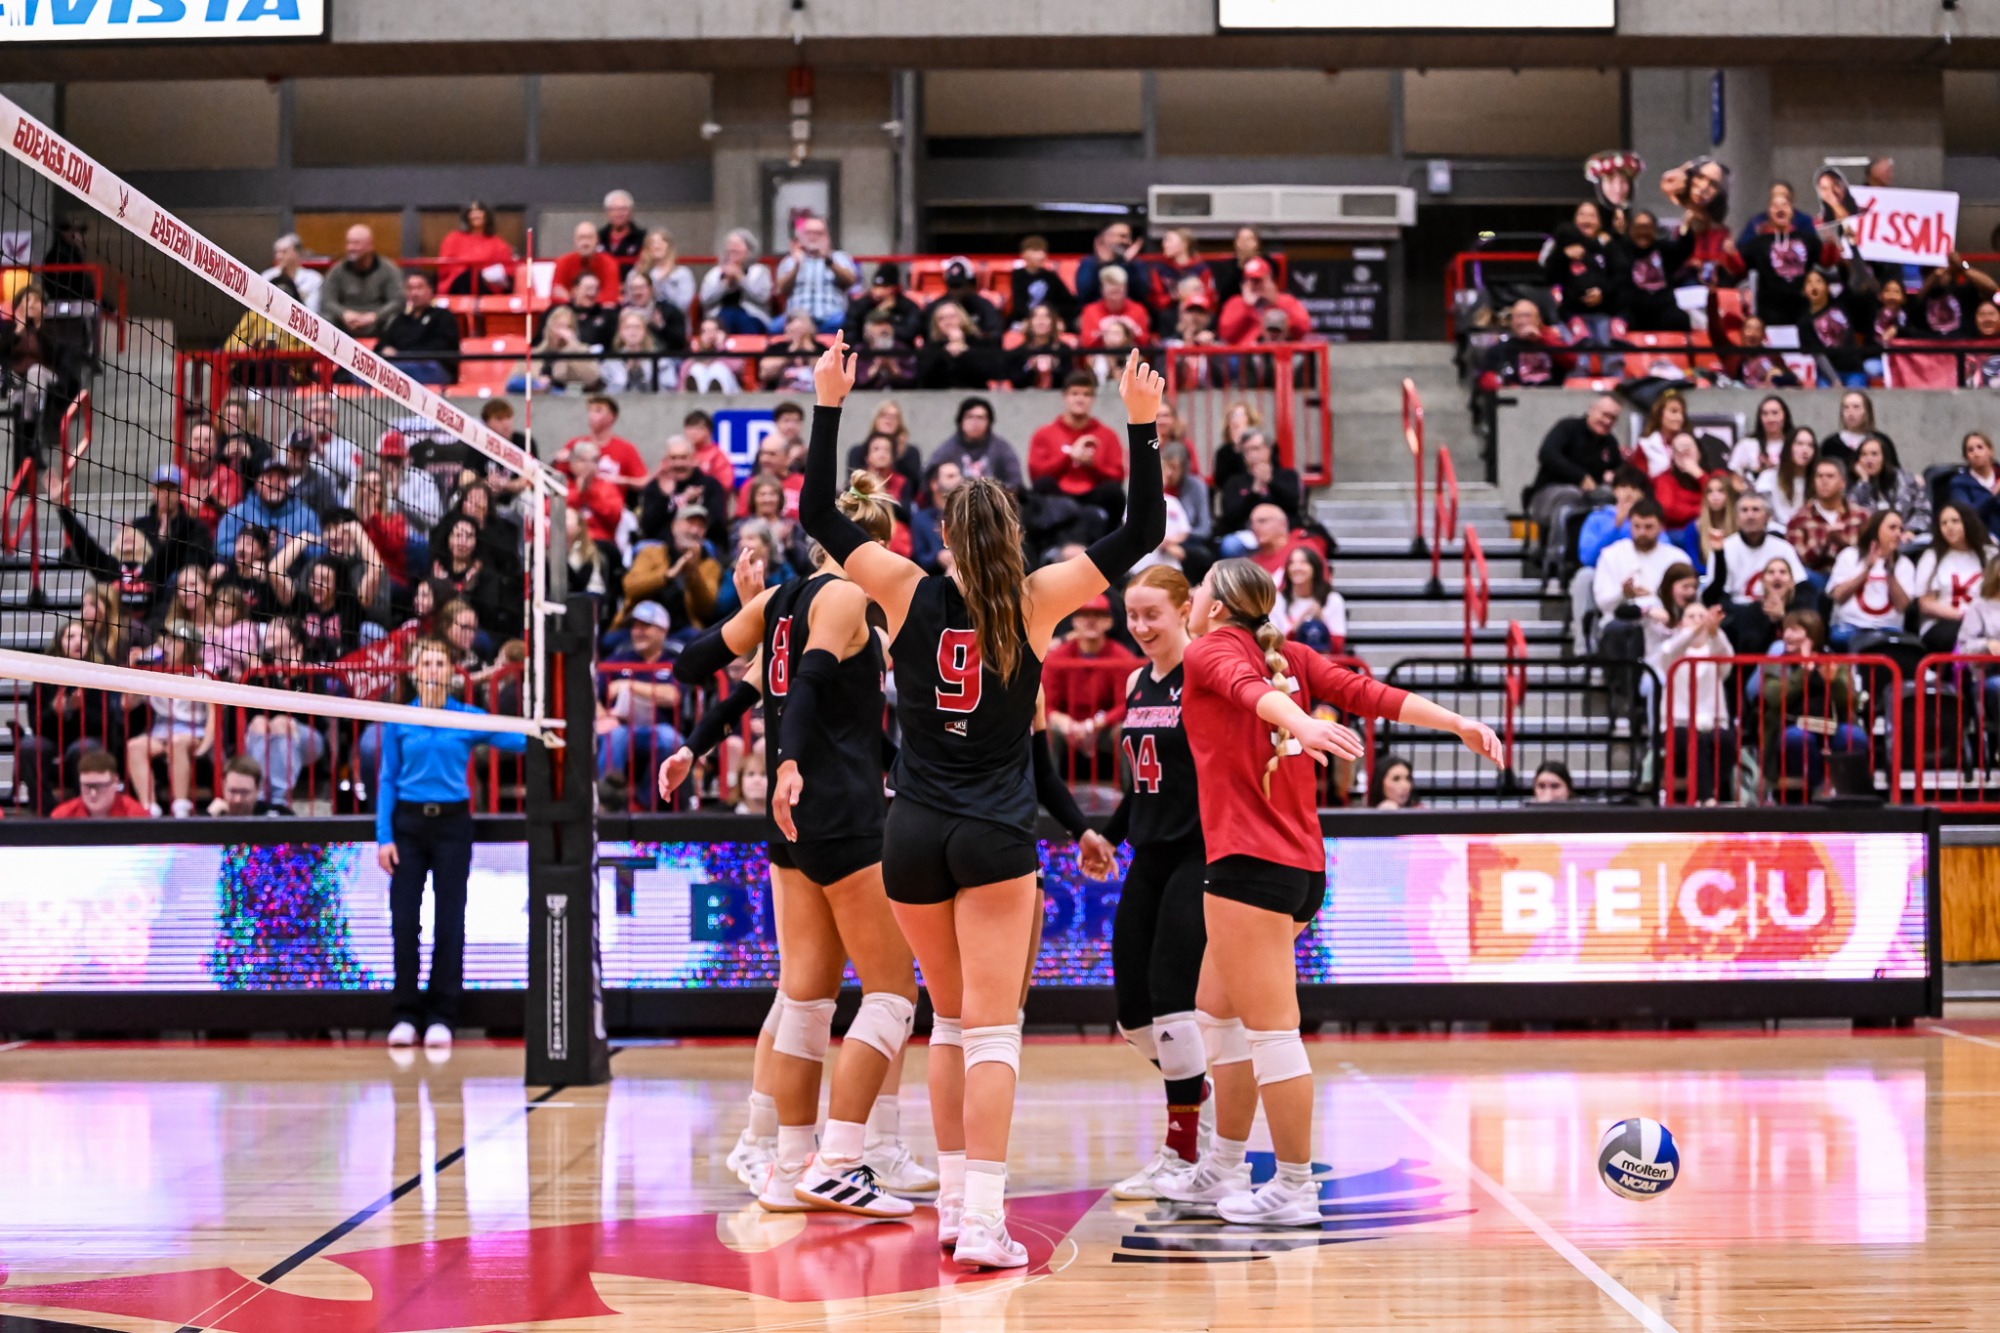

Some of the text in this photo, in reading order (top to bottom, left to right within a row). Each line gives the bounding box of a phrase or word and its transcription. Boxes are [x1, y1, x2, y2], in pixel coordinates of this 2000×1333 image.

[0, 0, 300, 26] VISTA
[13, 117, 93, 194] GOEAGS.COM
[150, 211, 249, 297] EASTERN WASHINGTON
[935, 628, 982, 713] 9
[1122, 734, 1162, 794] 14
[1619, 1173, 1659, 1192] NCAA
[1621, 1160, 1667, 1179] molten
